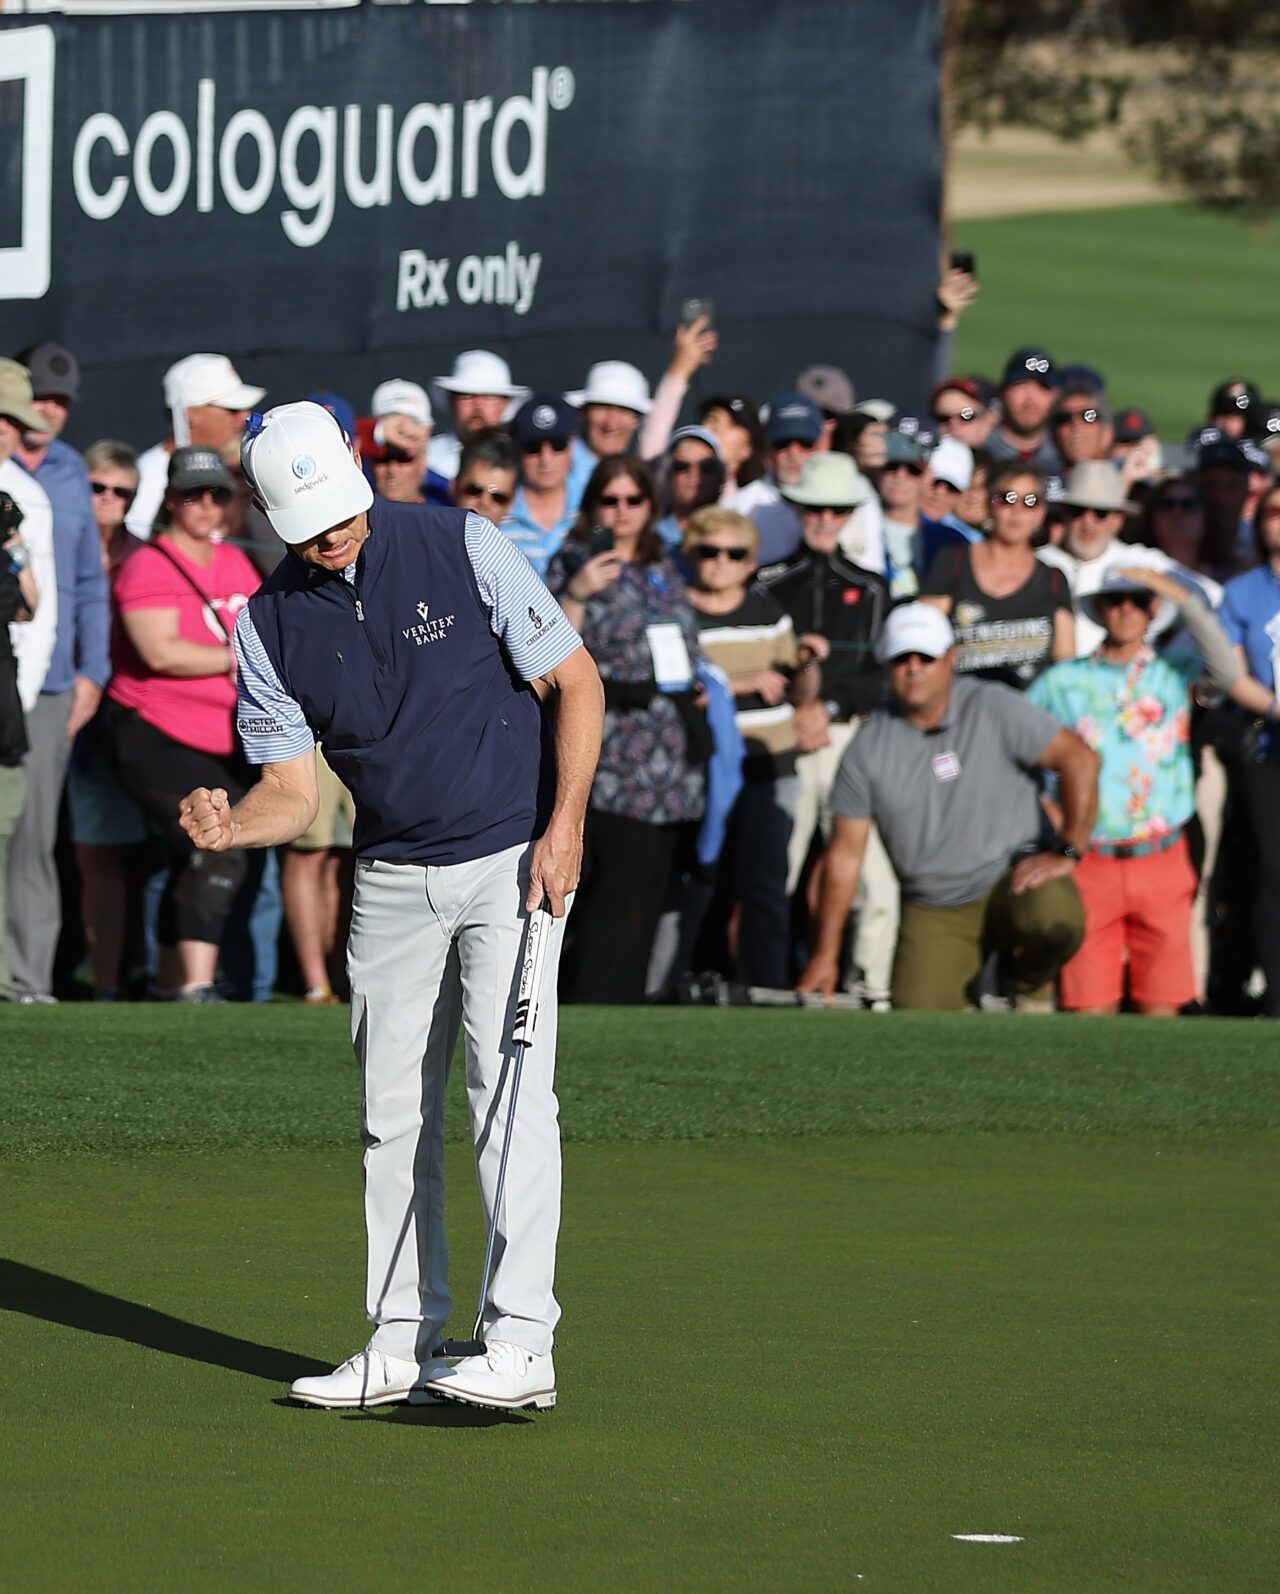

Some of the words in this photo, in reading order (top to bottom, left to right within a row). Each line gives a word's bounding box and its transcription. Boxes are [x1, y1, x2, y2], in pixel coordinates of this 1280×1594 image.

[397, 248, 448, 311] Rx
[457, 241, 542, 314] only
[415, 629, 447, 646] BANK
[248, 718, 276, 726] PETER
[249, 725, 284, 733] MILLAR
